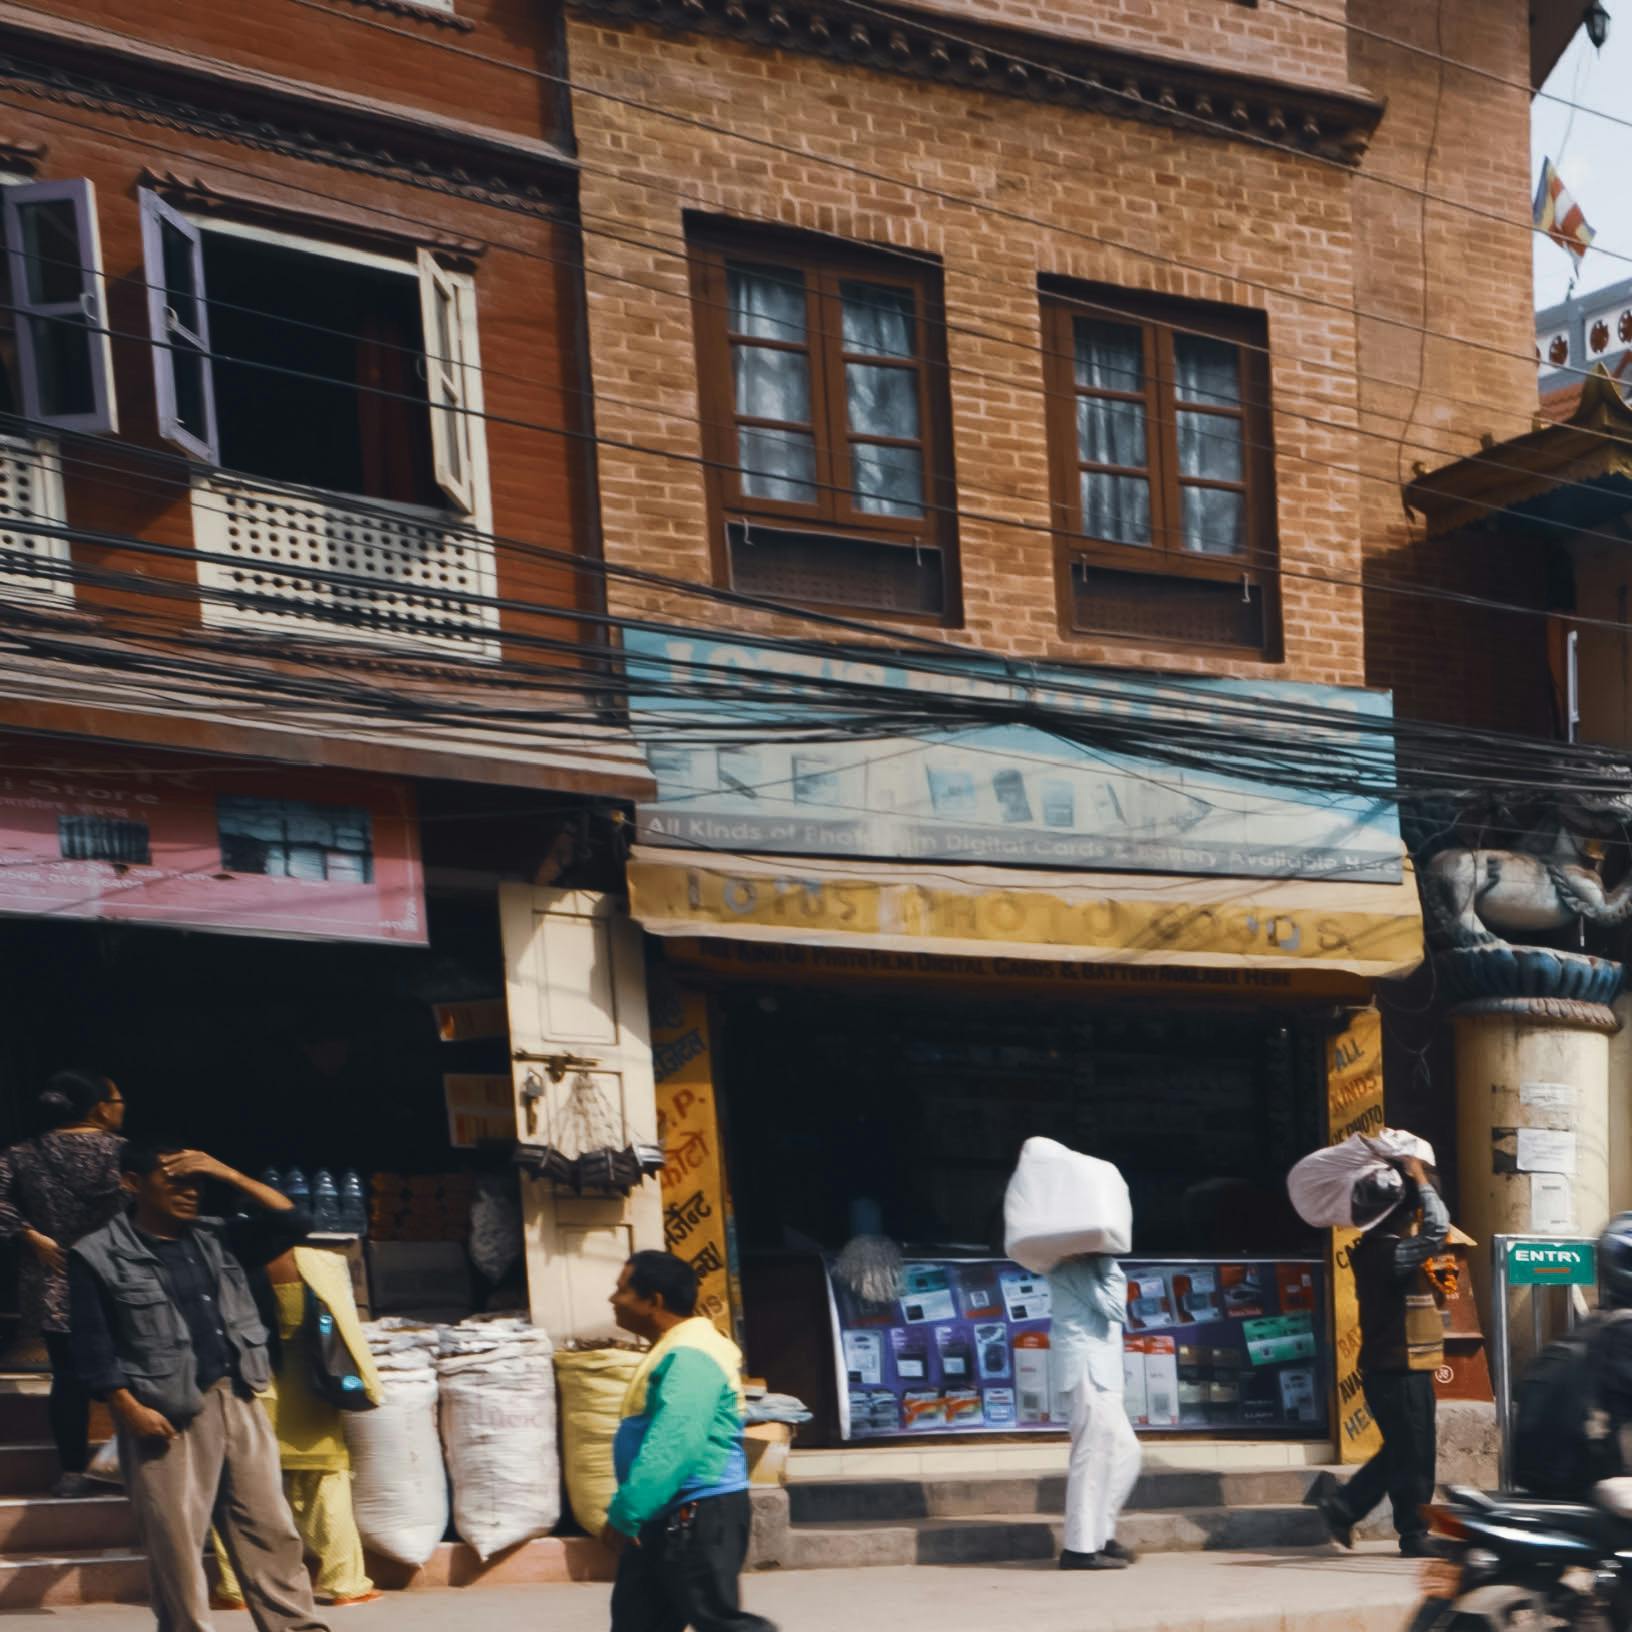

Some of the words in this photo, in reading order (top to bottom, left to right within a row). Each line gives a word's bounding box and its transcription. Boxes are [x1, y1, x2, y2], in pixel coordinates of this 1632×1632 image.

[649, 816, 680, 836] All
[689, 818, 762, 842] Kinds
[766, 821, 797, 842] of
[945, 834, 1025, 858] Digital
[1335, 1039, 1365, 1072] ALL
[1515, 1249, 1582, 1263] ENTRY
